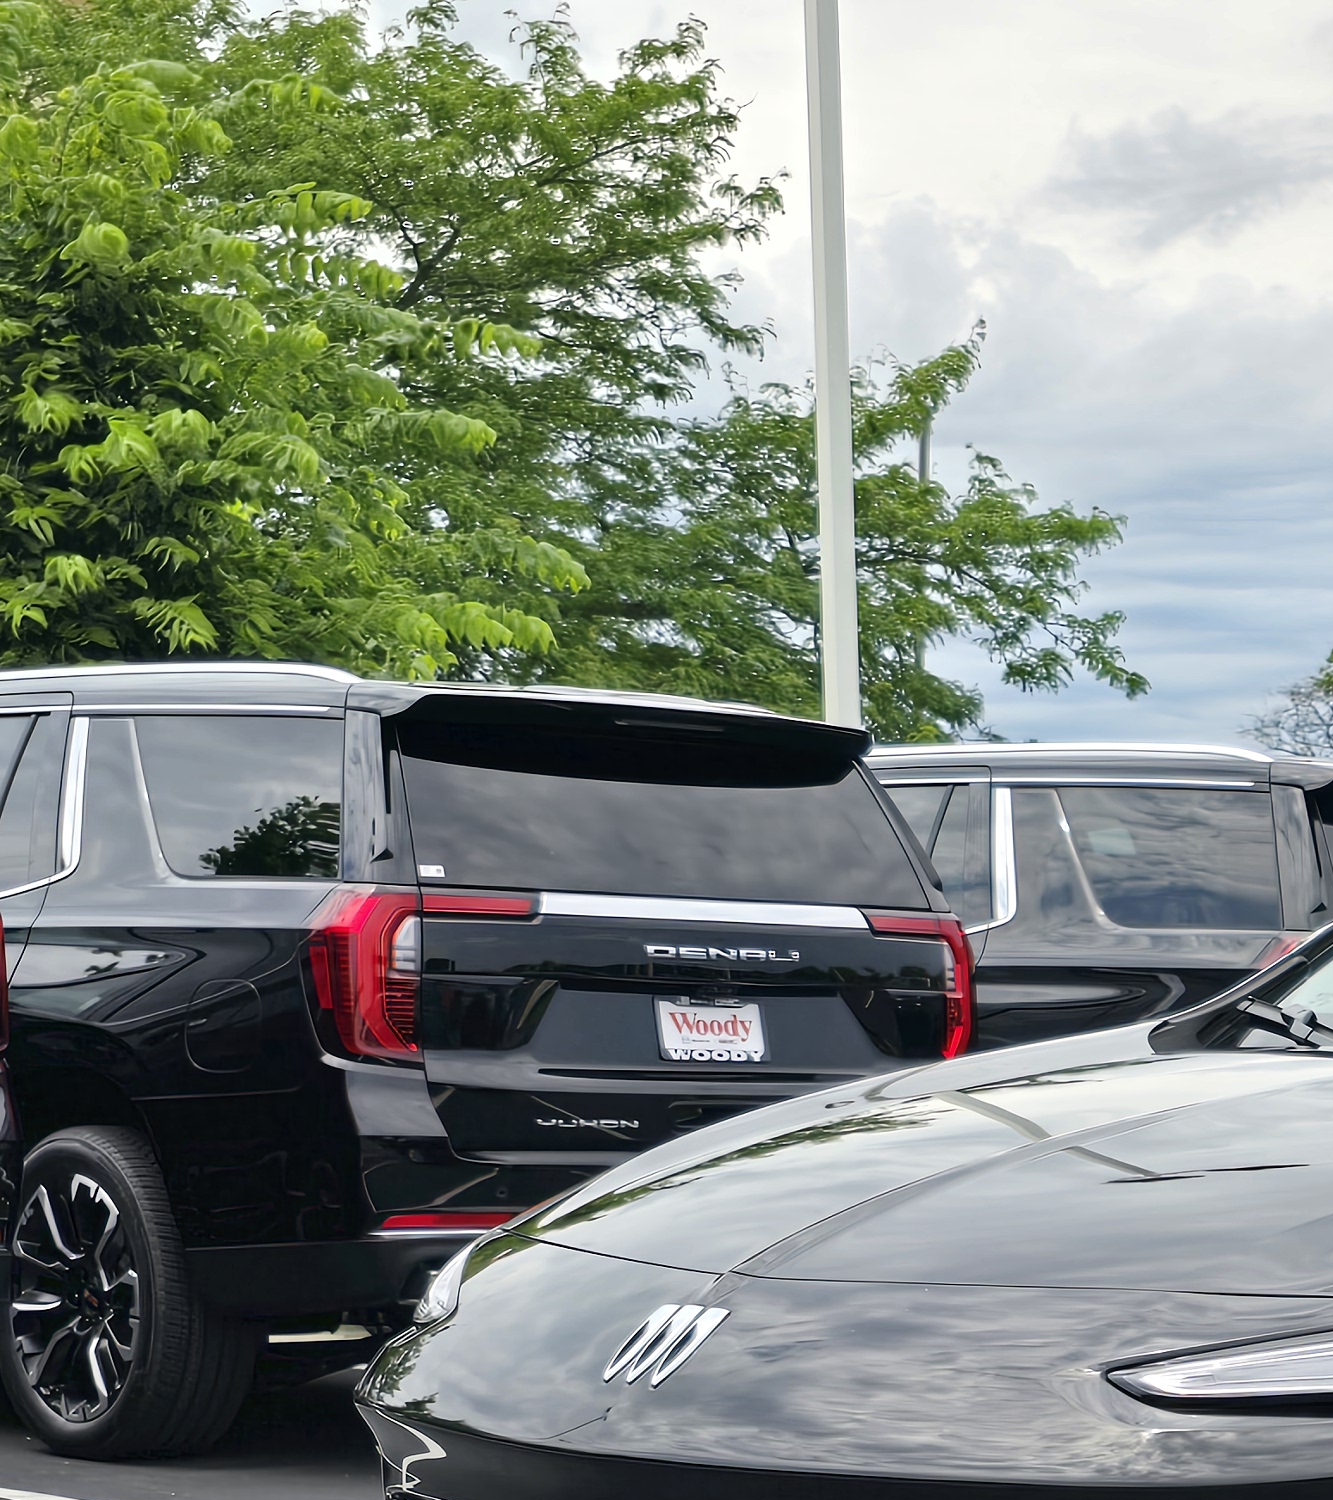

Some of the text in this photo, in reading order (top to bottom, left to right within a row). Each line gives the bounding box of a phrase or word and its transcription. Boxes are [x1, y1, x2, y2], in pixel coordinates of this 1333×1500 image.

[643, 944, 800, 962] DENALI
[669, 1012, 753, 1043] Woody
[668, 1049, 766, 1062] WOODY
[536, 1119, 640, 1129] YUKON
